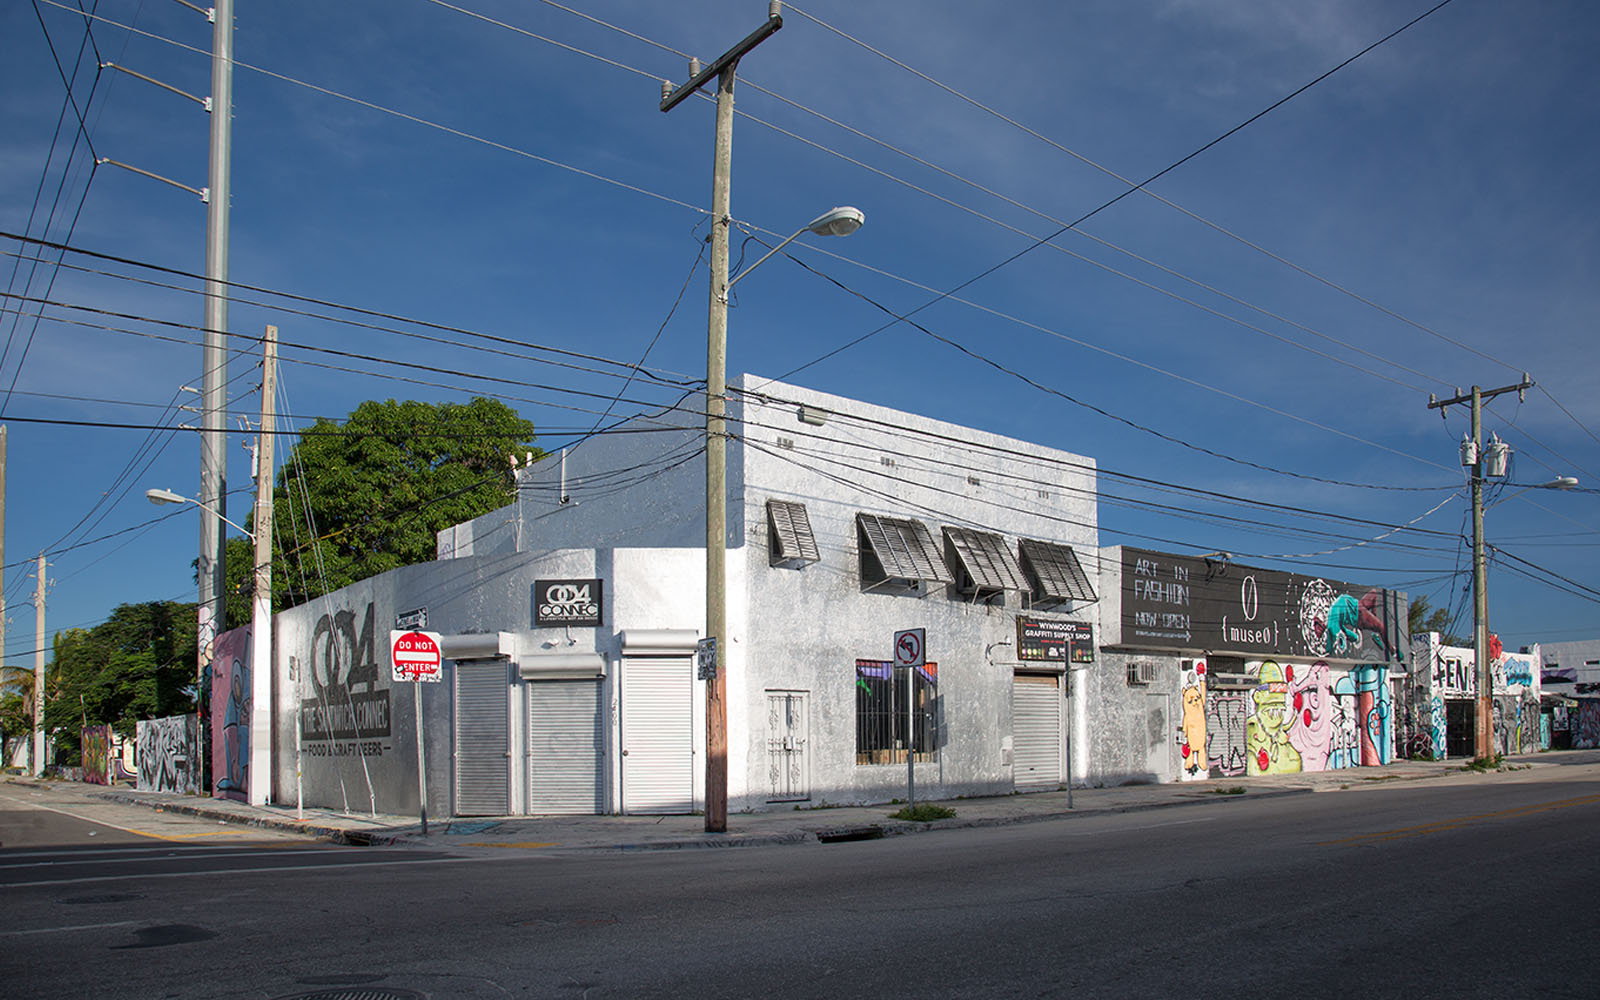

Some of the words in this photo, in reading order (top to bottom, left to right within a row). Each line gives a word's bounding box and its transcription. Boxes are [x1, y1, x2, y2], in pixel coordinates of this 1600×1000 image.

[1135, 558, 1159, 576] ART
[1174, 566, 1189, 581] IN
[1135, 579, 1189, 607] FASHION
[539, 603, 598, 617] CONNEC
[1038, 622, 1077, 632] WYNWOOD'S
[1135, 611, 1157, 628] NOW
[1162, 612, 1190, 630] OPEN
[1025, 629, 1053, 638] GRAFFITI
[1053, 631, 1074, 640] SUPPLY
[398, 640, 412, 650] DO
[415, 641, 433, 651] NOT
[403, 662, 431, 672] ENTER
[303, 706, 316, 732] THE
[357, 699, 388, 730] CONNEC
[309, 743, 327, 757] FOOD
